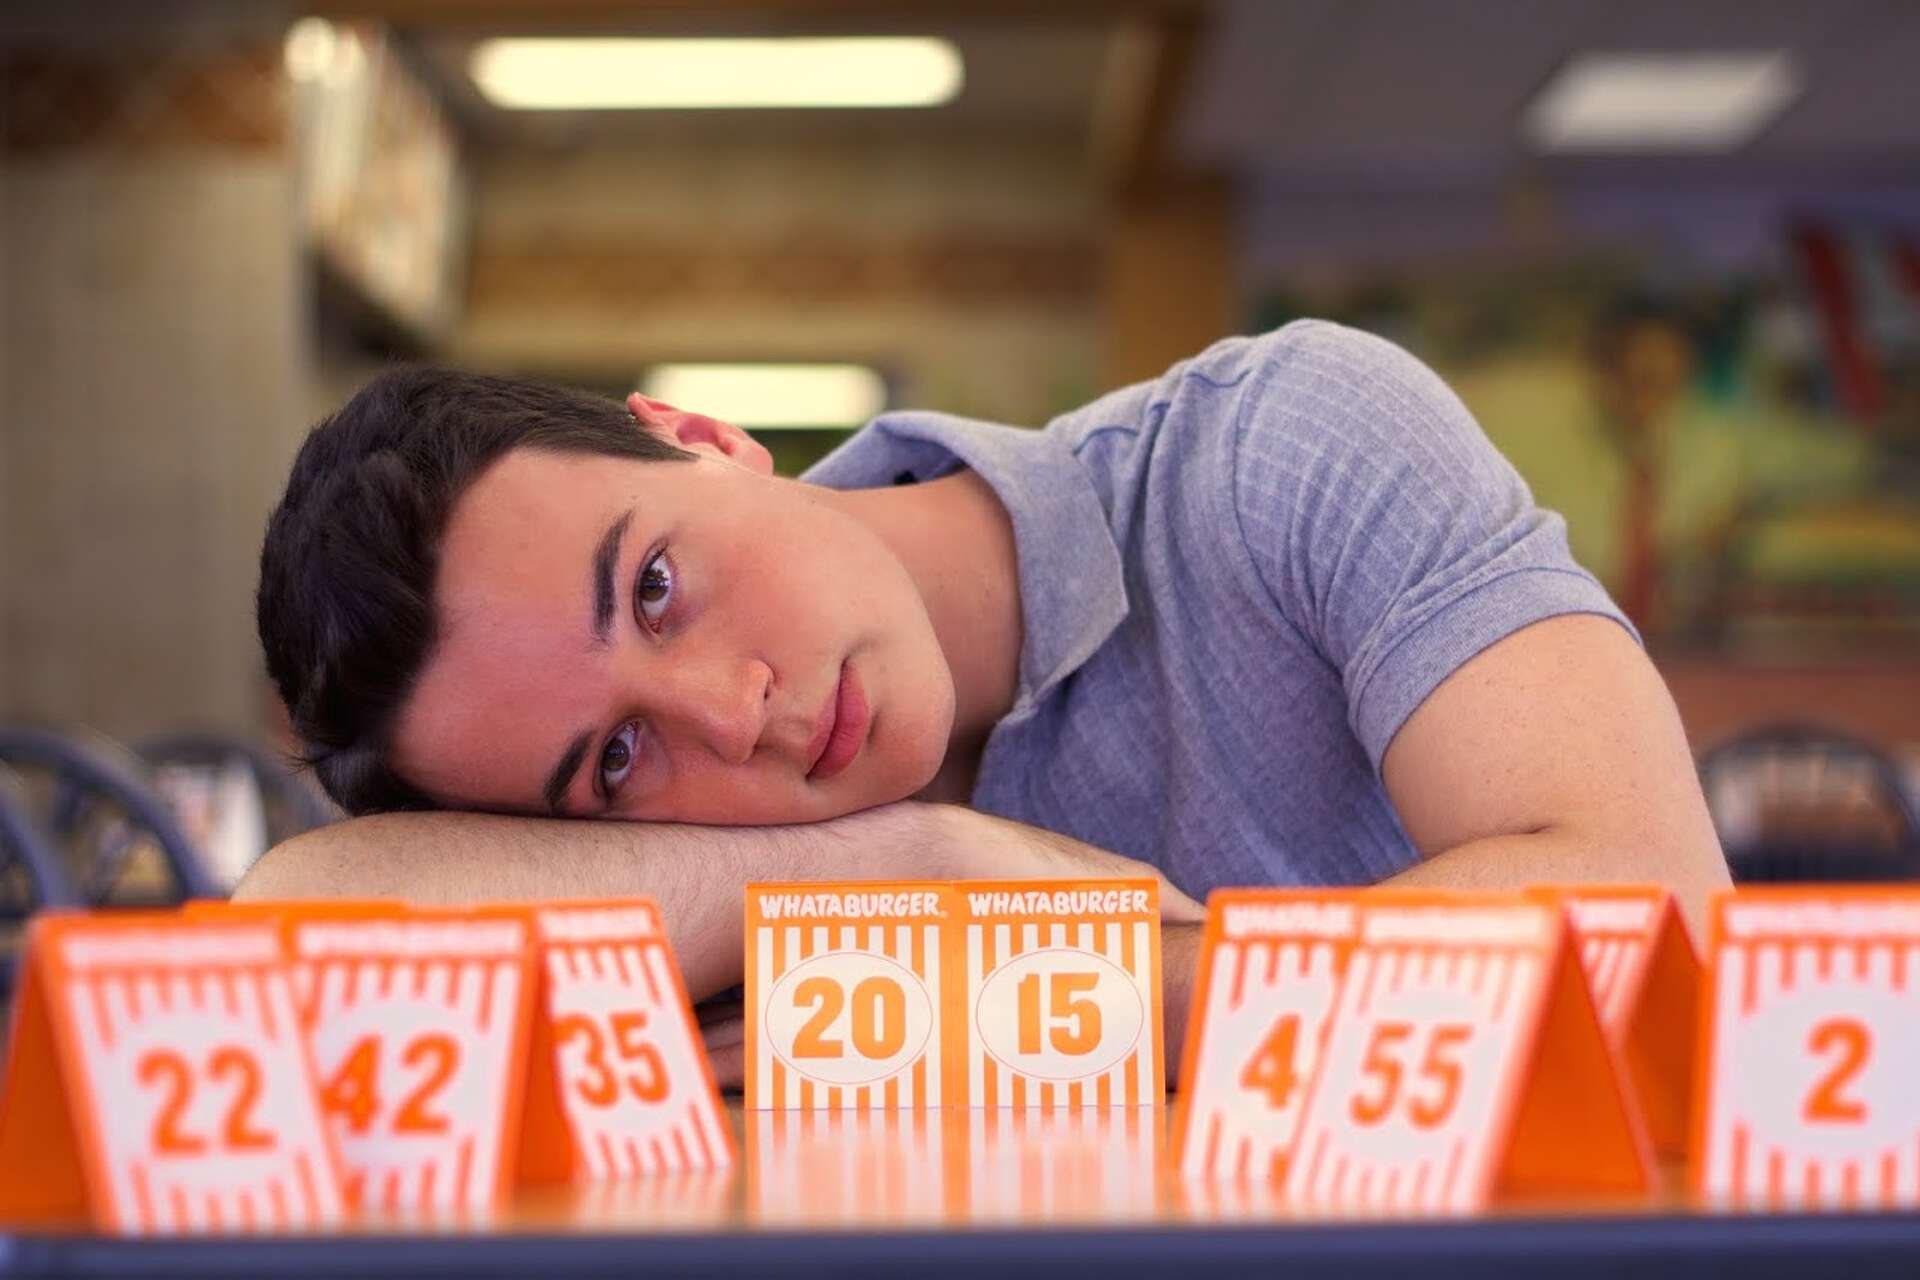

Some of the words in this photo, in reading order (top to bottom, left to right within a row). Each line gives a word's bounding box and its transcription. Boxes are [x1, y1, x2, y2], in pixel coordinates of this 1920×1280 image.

[759, 893, 939, 918] WHATABURGER
[968, 890, 1148, 917] WHATABURGER
[551, 1010, 671, 1107] 35
[792, 976, 906, 1059] 20
[1017, 972, 1102, 1057] 15
[136, 1046, 276, 1154] 22
[321, 1033, 460, 1137] 42
[1349, 1022, 1473, 1129] 55
[1803, 1017, 1872, 1122] 2
